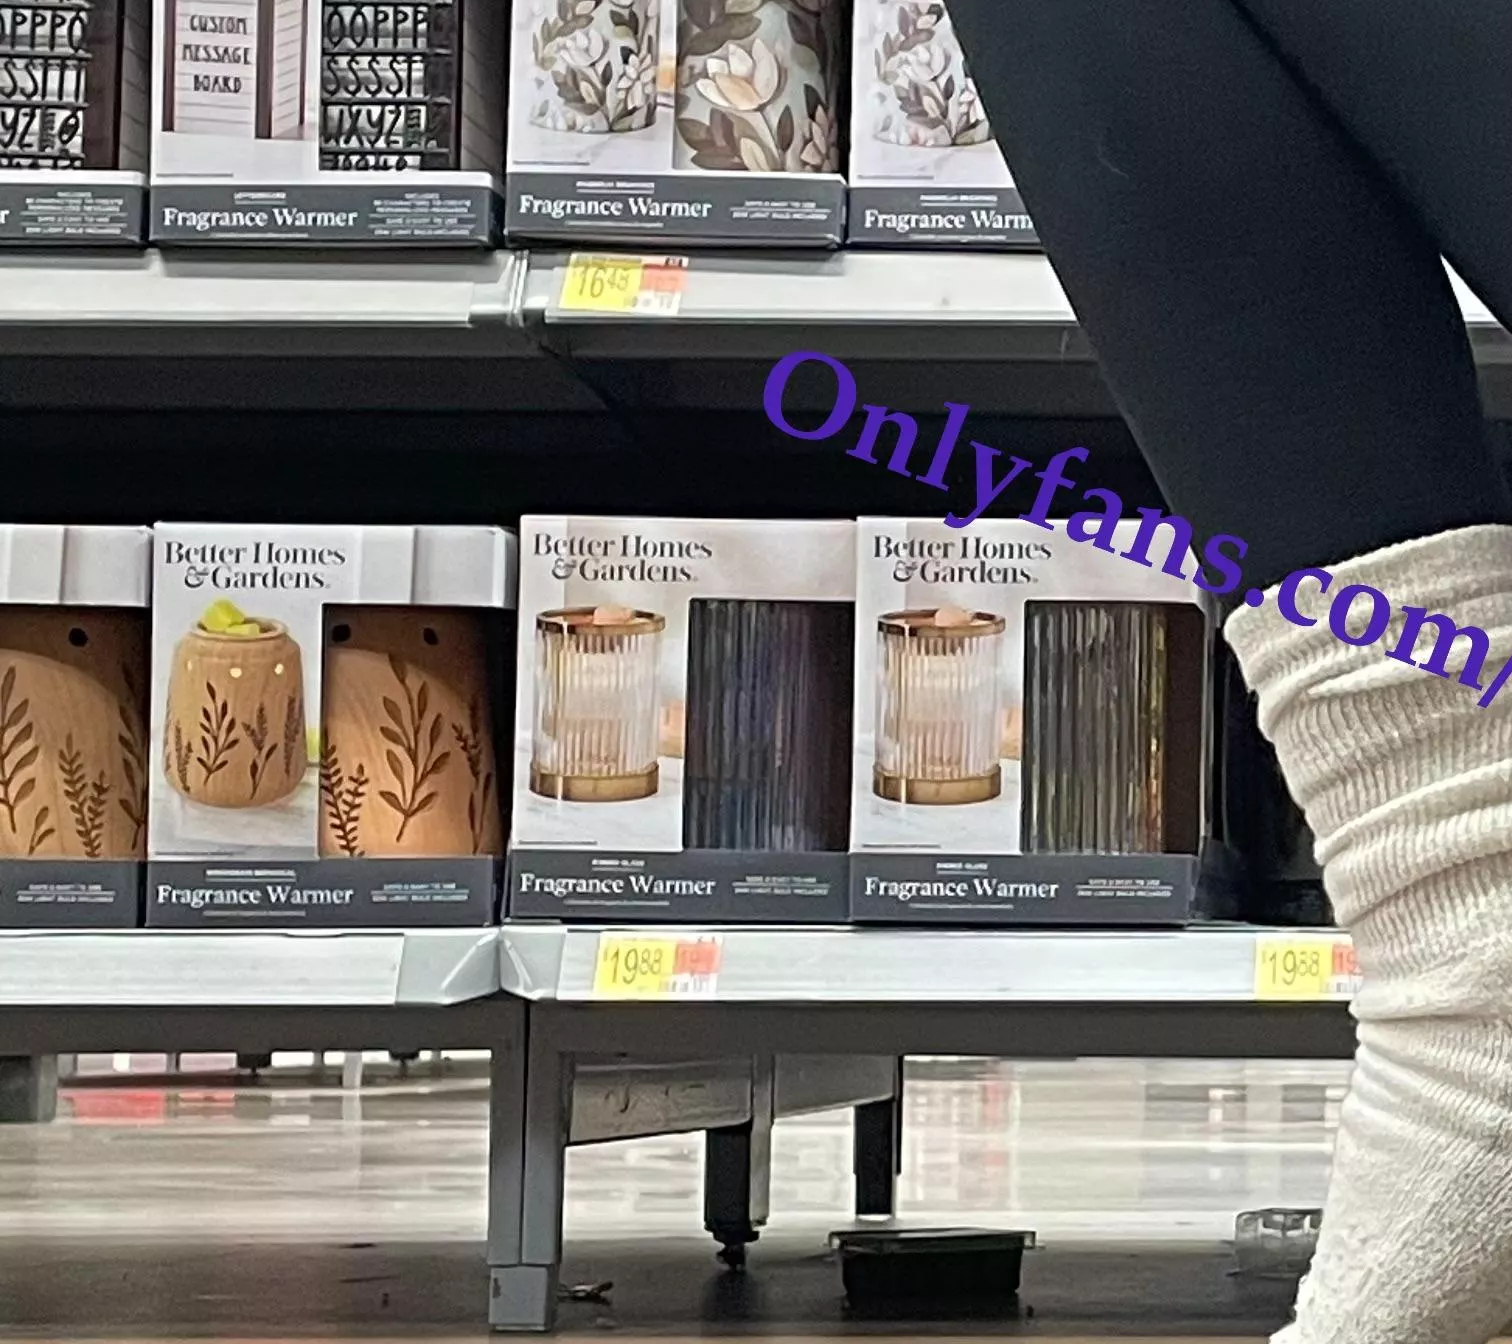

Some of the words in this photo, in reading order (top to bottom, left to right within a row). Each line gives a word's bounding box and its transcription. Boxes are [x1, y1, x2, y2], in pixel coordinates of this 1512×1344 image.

[190, 15, 249, 35] CUSTOM
[182, 44, 254, 66] MESSAGE
[193, 74, 243, 94] BOARD
[163, 207, 269, 231] Fragrance
[272, 207, 359, 227] Warmer
[519, 194, 623, 219] Fragrance
[628, 197, 713, 218] Warmer
[864, 209, 966, 233] Fragrance
[971, 209, 1034, 229] Warm
[165, 540, 248, 565] Better
[253, 541, 346, 566] Homes
[534, 533, 616, 557] Better
[620, 534, 713, 559] Homes
[874, 535, 956, 559] Better
[960, 536, 1053, 560] Homes
[156, 884, 262, 909] Fragrance
[266, 885, 354, 905] Warmer
[520, 872, 625, 897] Fragrance
[629, 875, 717, 895] Warmer
[864, 876, 969, 901] Fragrance
[973, 878, 1060, 898] Warmer
